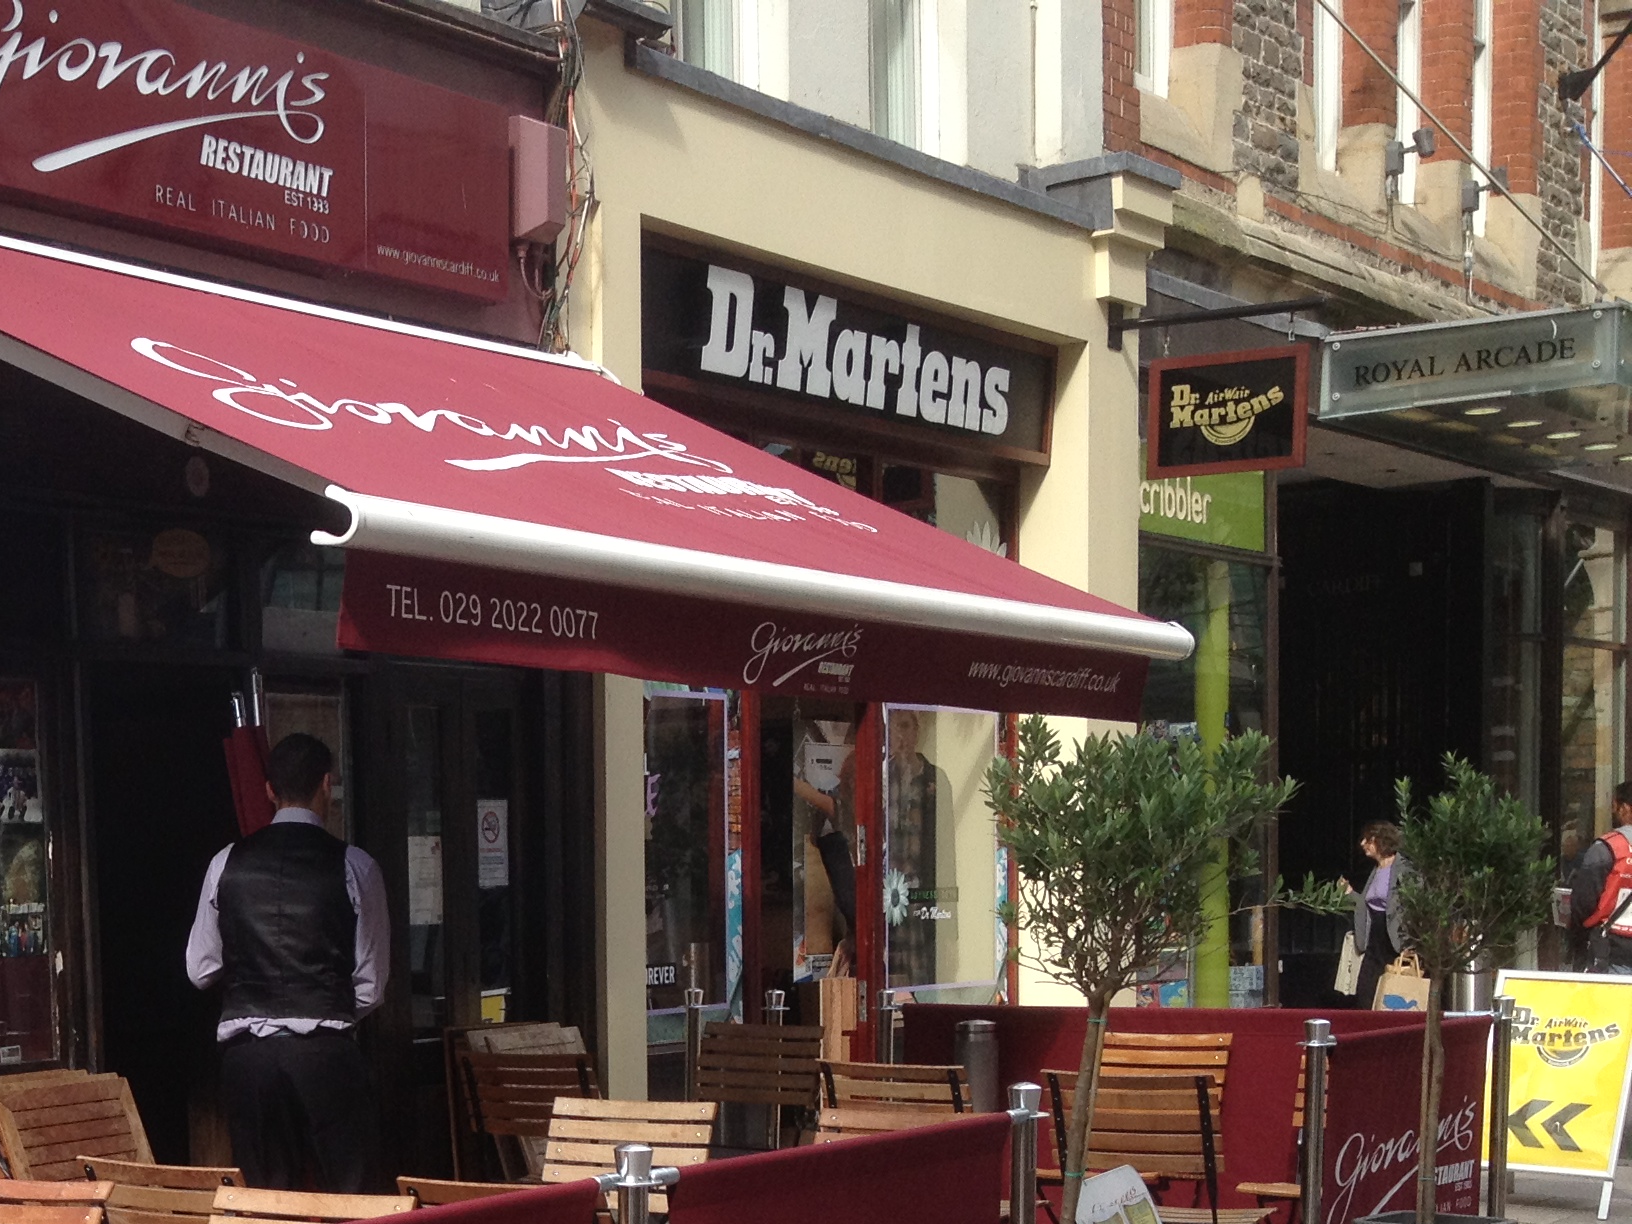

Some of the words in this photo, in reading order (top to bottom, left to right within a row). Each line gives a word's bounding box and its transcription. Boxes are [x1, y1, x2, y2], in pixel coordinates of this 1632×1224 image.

[200, 133, 333, 197] RESTAURANT
[155, 184, 197, 211] REAL
[212, 199, 275, 231] ITALIAN
[289, 218, 330, 243] FOOD
[284, 190, 304, 207] EST
[1353, 355, 1446, 388] ROYAL
[1453, 337, 1576, 374] ARCADE
[1169, 385, 1285, 429] Martens
[1205, 386, 1251, 406] AirWair
[386, 584, 434, 622] TEL.
[439, 590, 482, 626] 029
[490, 597, 543, 634] 2022
[549, 605, 598, 640] 0077
[968, 660, 1120, 693] www.giovanniscardiff.co.uk
[645, 966, 676, 986] REVER
[1511, 1022, 1620, 1047] Martens
